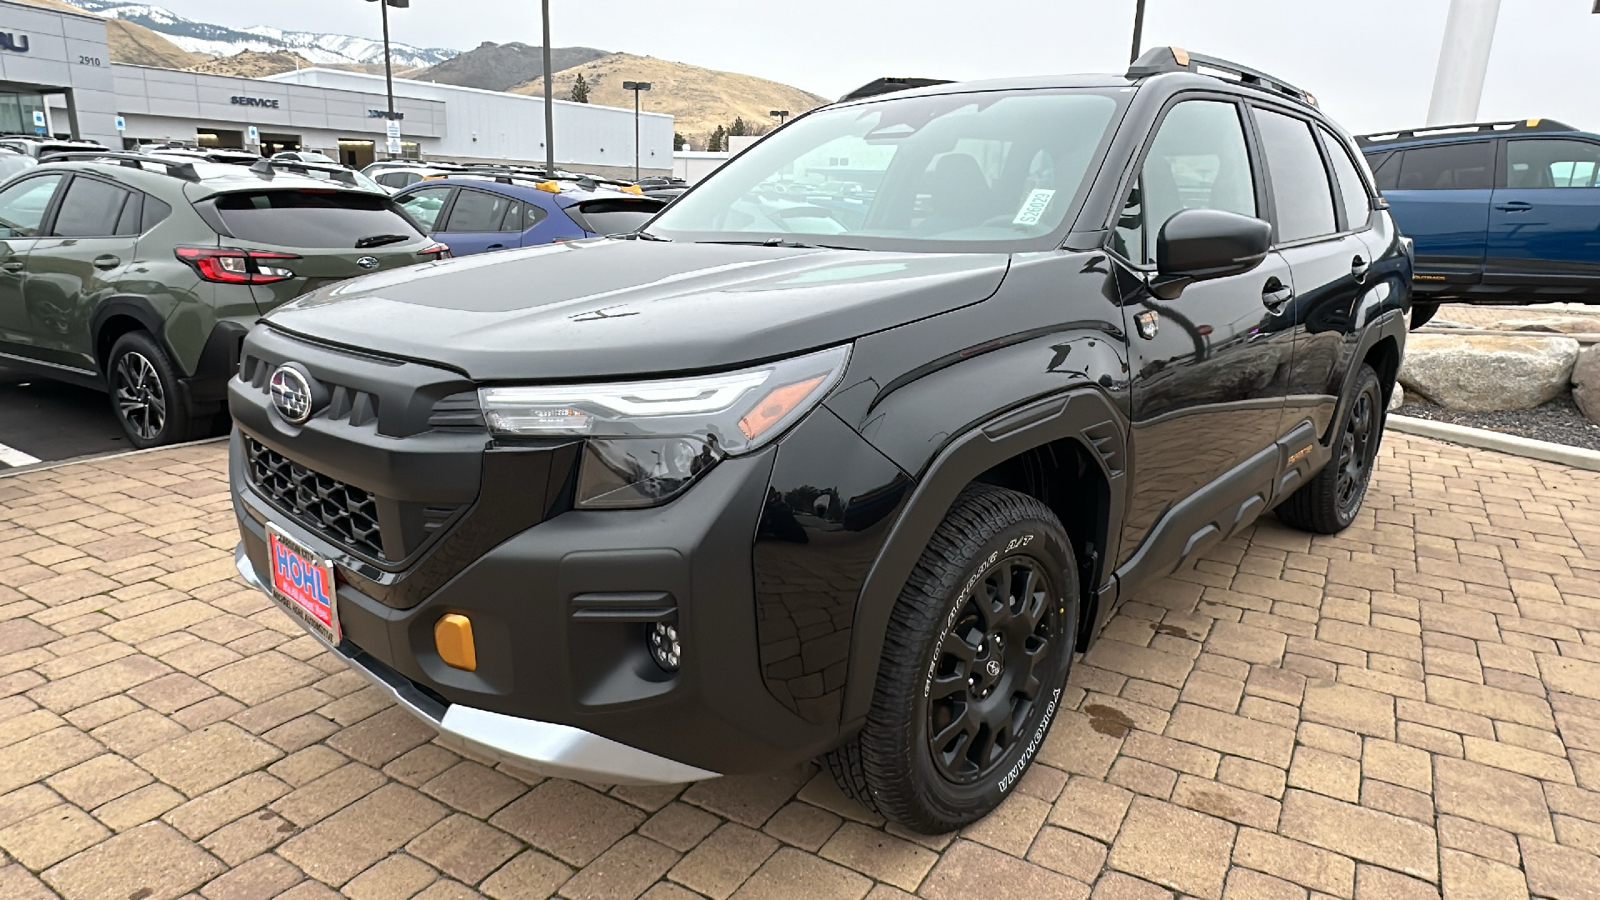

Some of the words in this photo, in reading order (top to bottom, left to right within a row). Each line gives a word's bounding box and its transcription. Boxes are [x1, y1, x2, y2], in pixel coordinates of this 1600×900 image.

[79, 55, 101, 67] 2910
[231, 96, 279, 109] SERVICE
[1020, 193, 1050, 223] S26029
[275, 542, 331, 608] HOHL
[304, 613, 334, 644] AUTOMOTIVE
[997, 687, 1061, 792] YOKOHAMA
